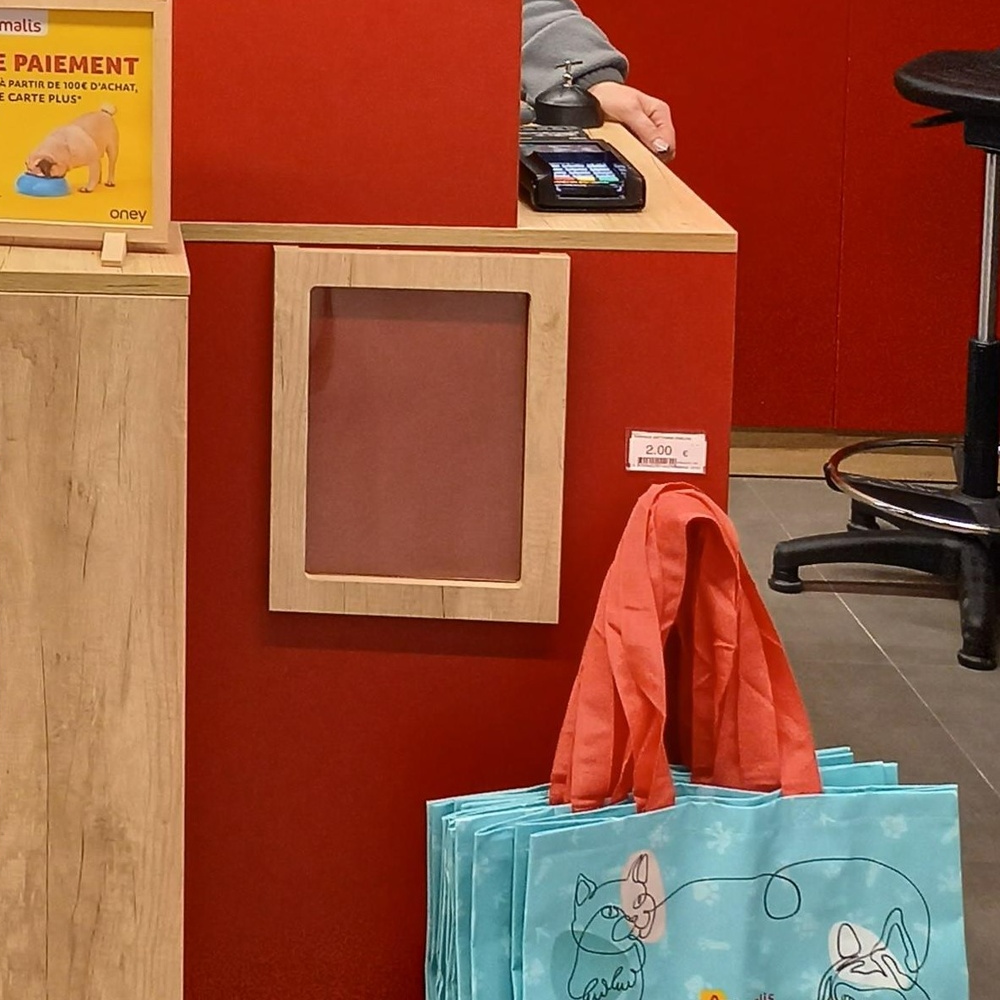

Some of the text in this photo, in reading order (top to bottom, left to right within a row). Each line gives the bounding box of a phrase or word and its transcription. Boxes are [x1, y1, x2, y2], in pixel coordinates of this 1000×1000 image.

[13, 54, 139, 75] PAIEMENT
[8, 80, 45, 89] PARTIR
[47, 81, 60, 89] DE
[63, 81, 88, 90] 100€
[90, 82, 138, 93] D'ACHAT,
[8, 93, 45, 103] CARTE
[110, 209, 147, 222] oney
[646, 444, 673, 456] 2.00
